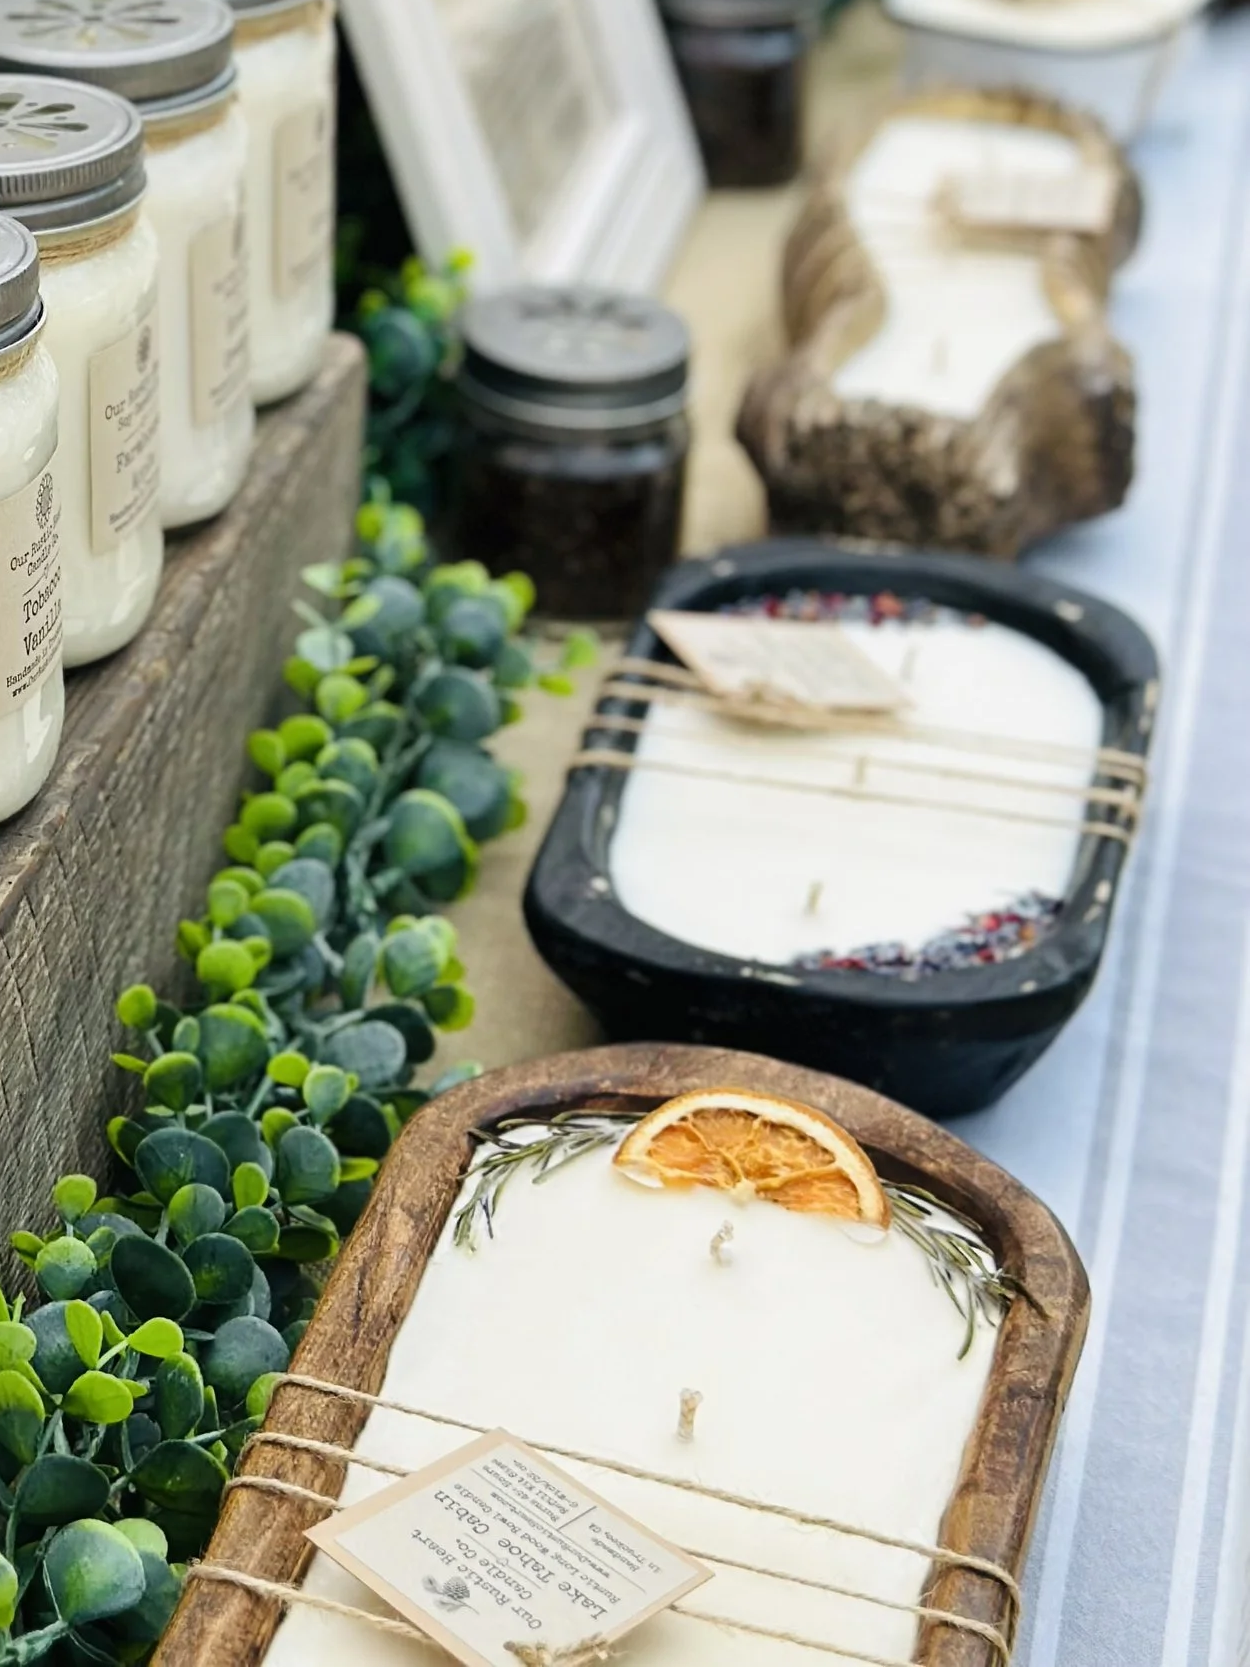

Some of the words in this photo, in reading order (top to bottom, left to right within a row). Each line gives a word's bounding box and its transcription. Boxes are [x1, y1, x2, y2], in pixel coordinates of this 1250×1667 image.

[105, 399, 126, 421] Our
[10, 552, 29, 571] Our
[32, 525, 53, 557] Rustic
[28, 544, 51, 577] Candle
[23, 565, 61, 624] Tobacco
[23, 598, 61, 656] Vanilla
[6, 653, 41, 688] Handmade
[482, 1465, 512, 1488] Hours
[517, 1477, 535, 1492] Kit
[434, 1490, 489, 1535] Cabin
[454, 1483, 493, 1513] Candle
[531, 1500, 560, 1522] Burns
[535, 1490, 568, 1514] Refill
[490, 1491, 610, 1578] www.OurRusticHeart.com
[493, 1513, 521, 1535] Bowl
[589, 1523, 602, 1534] CA
[411, 1529, 456, 1566] Heart
[456, 1538, 477, 1560] Co.
[520, 1532, 549, 1555] Wood
[591, 1537, 639, 1572] Handmade
[604, 1532, 647, 1564] Truckee,
[498, 1538, 555, 1584] Tahoe
[550, 1551, 579, 1576] Long
[648, 1562, 662, 1573] in
[457, 1564, 511, 1606] Rustic
[479, 1558, 533, 1601] Candle
[580, 1574, 621, 1604] Rustic
[558, 1581, 608, 1620] Lake
[511, 1606, 542, 1630] Our
